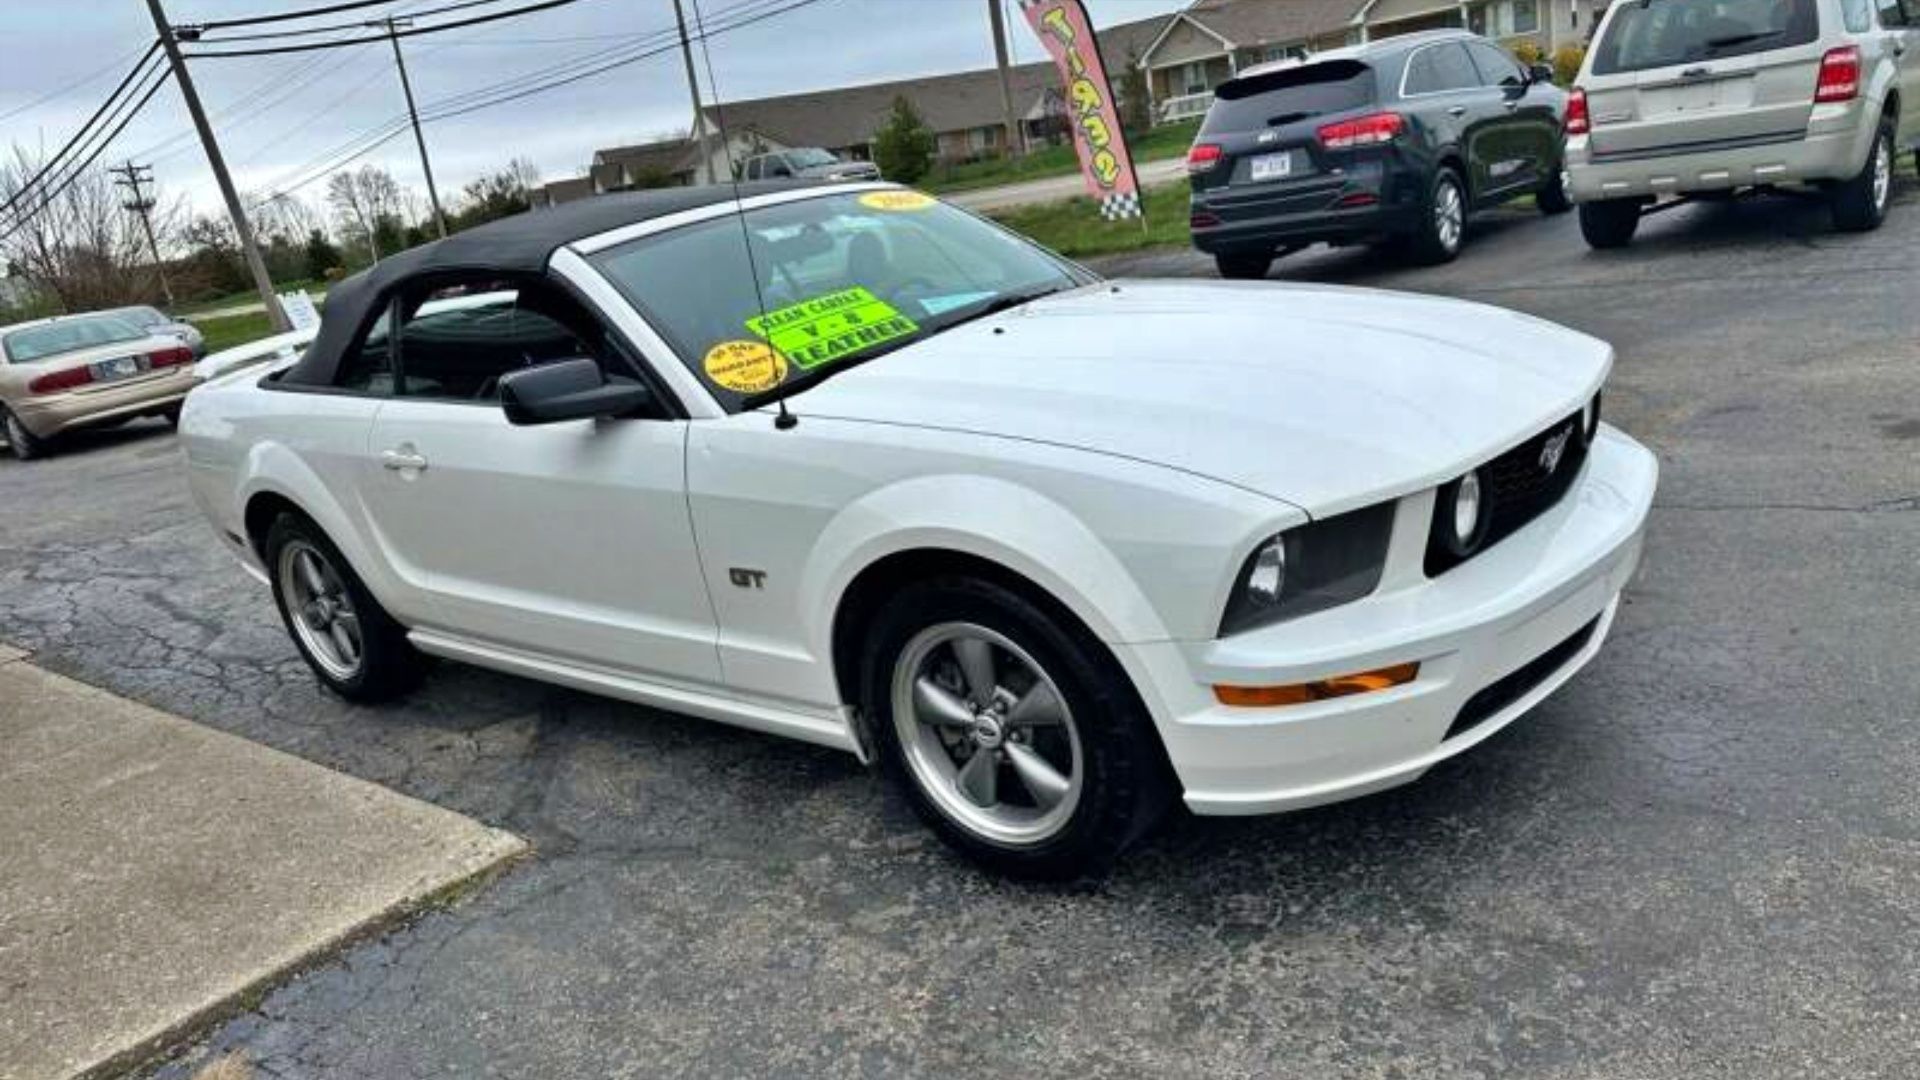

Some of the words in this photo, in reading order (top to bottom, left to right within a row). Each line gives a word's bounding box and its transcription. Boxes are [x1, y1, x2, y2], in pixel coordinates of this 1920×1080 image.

[758, 307, 807, 330] CLEAN
[792, 317, 912, 364] LEATHER
[729, 567, 767, 588] GT
